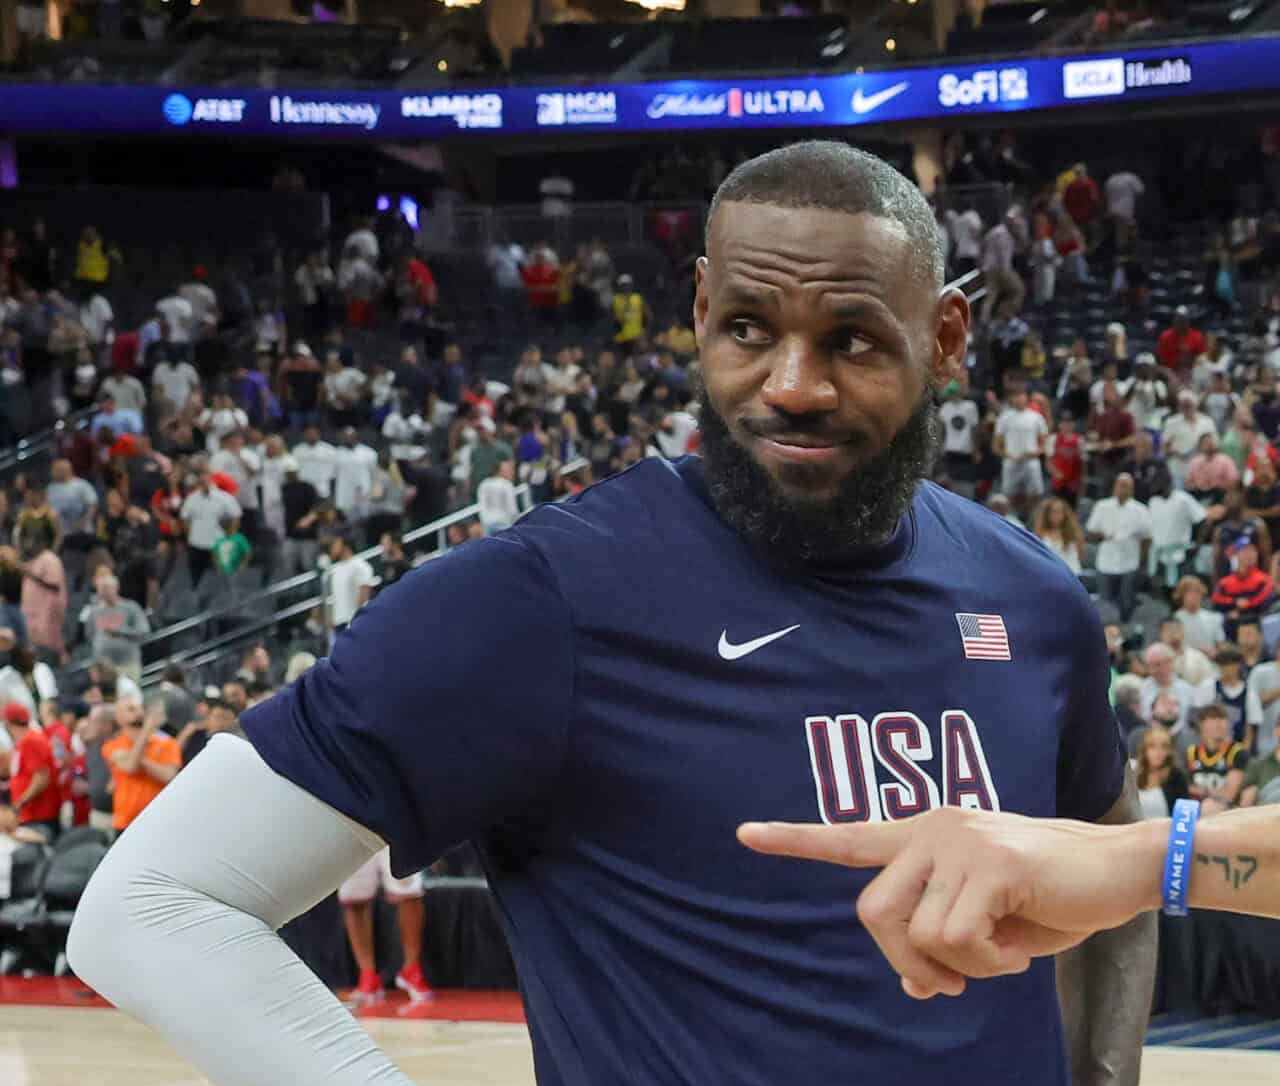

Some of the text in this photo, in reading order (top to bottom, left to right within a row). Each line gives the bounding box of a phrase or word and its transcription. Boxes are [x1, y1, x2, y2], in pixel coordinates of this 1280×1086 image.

[1126, 58, 1191, 87] Health
[565, 92, 616, 112] MGM
[743, 89, 825, 115] ULTRA
[938, 71, 998, 106] SoFi
[192, 98, 246, 122] AT&T
[269, 95, 380, 129] Hennessy
[401, 94, 502, 117] KUMHO
[804, 709, 1001, 827] USA
[1167, 852, 1185, 902] NAME
